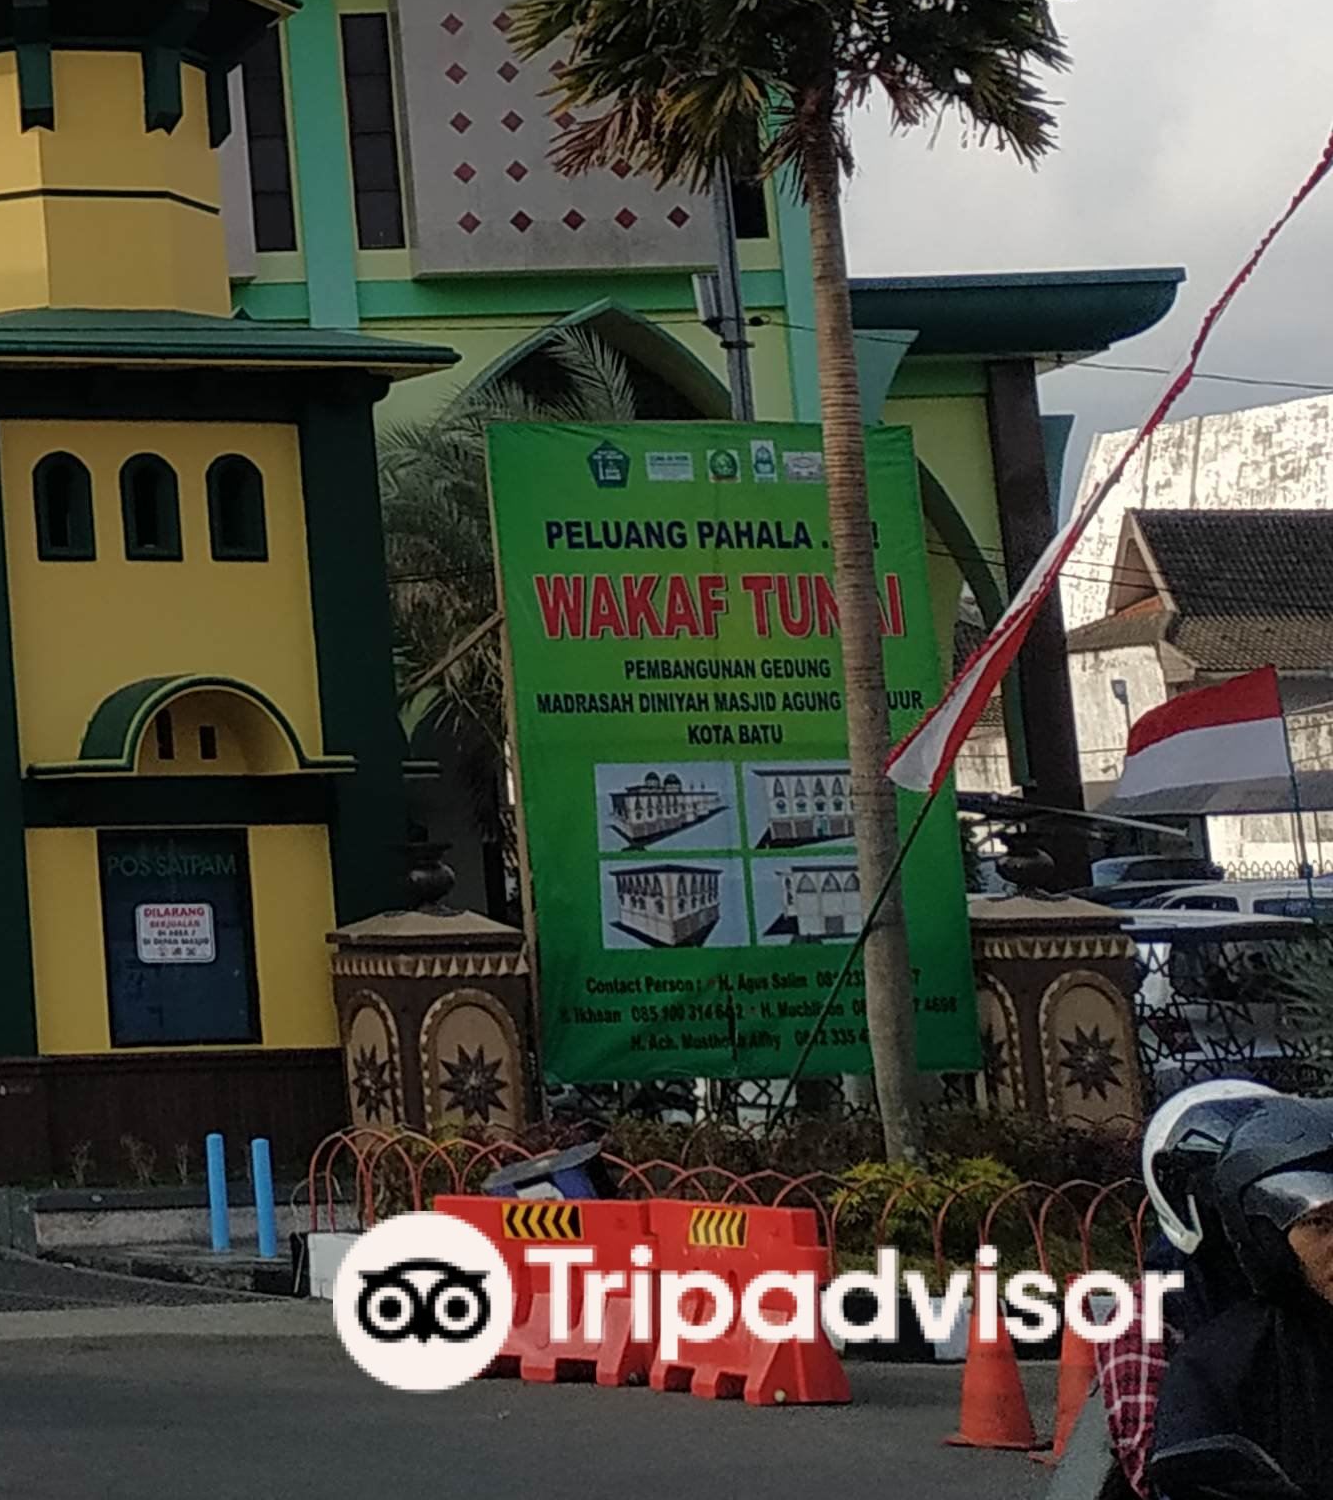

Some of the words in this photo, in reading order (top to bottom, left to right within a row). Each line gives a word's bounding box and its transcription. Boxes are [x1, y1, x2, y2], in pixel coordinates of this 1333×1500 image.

[545, 520, 688, 549] PELUANG
[697, 520, 813, 549] PAHALA
[535, 573, 728, 640] WAKAF
[740, 572, 907, 639] TUNI
[624, 659, 756, 681] PEMBANGUNAN
[761, 658, 832, 679] GEDUNG
[536, 692, 633, 714] MADRASAH
[639, 692, 709, 714] DINIYAH
[715, 692, 777, 712] MASJID
[782, 691, 842, 711] AGUNG
[687, 724, 735, 745] KOTA
[739, 724, 783, 744] BATU
[107, 855, 152, 877] POS
[156, 853, 237, 877] SATPAM
[143, 907, 205, 918] DILARANG
[586, 976, 642, 994] Contact
[645, 975, 694, 993] Person
